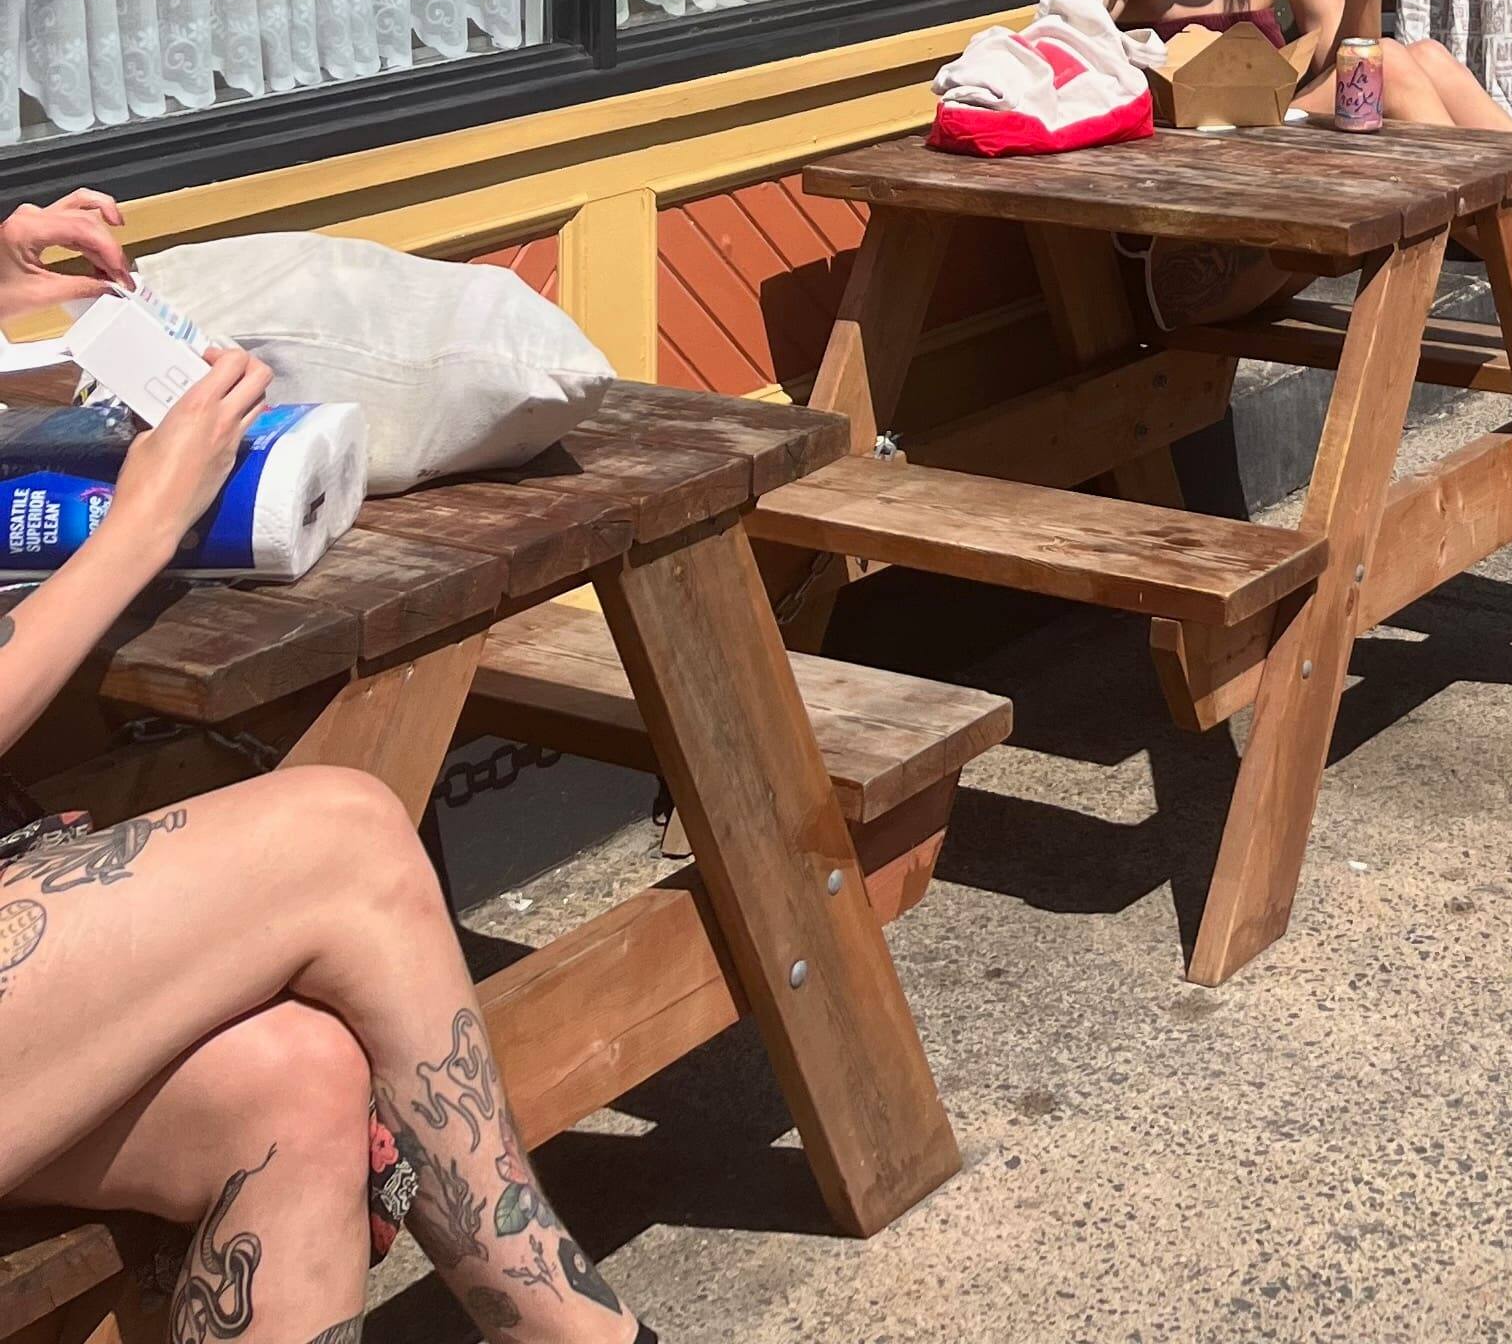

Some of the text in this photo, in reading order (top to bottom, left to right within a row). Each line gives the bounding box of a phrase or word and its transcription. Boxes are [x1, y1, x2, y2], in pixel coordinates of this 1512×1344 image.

[1347, 61, 1369, 92] La
[10, 487, 30, 554] VERSATILE
[27, 490, 47, 552] SUPERIOR
[44, 502, 61, 544] CLEAN
